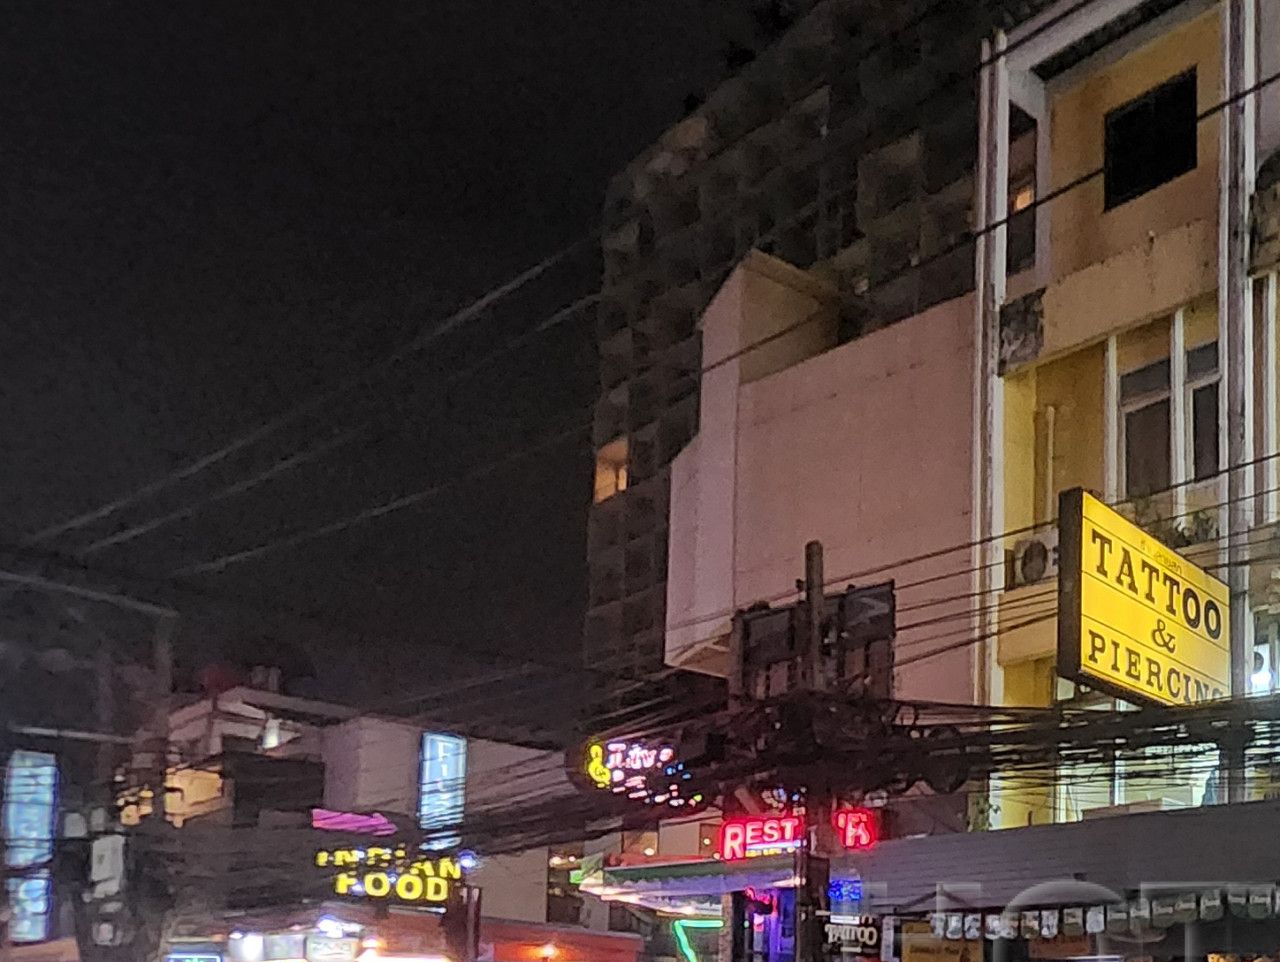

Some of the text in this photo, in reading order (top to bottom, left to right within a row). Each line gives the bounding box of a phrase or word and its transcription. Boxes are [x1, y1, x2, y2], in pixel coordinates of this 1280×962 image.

[1091, 528, 1222, 641] TATTOO
[1151, 618, 1176, 654] &
[335, 870, 449, 902] FOOD
[825, 923, 878, 946] TATTOO
